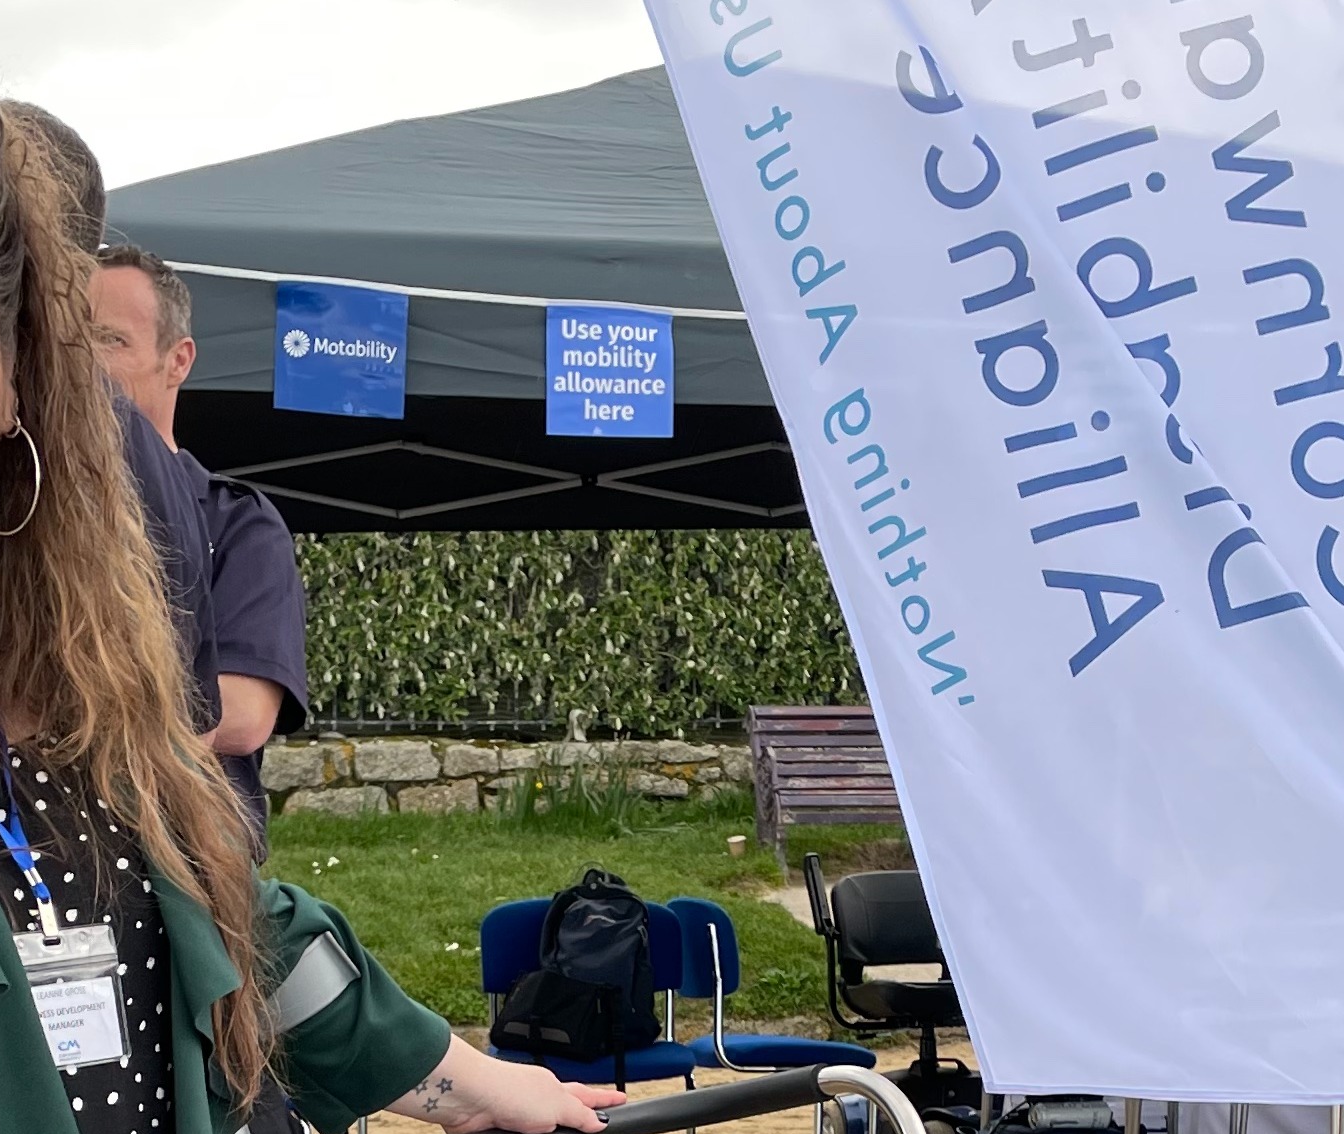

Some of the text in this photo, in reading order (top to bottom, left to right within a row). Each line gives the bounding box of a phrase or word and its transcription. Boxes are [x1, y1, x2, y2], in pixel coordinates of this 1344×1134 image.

[561, 318, 659, 346] Use your
[313, 337, 398, 364] Motability
[562, 344, 658, 373] mobility
[553, 370, 666, 395] allowance
[584, 398, 635, 421] here
[56, 1001, 106, 1017] DEVELOPMENT
[48, 1019, 85, 1032] MANAGER
